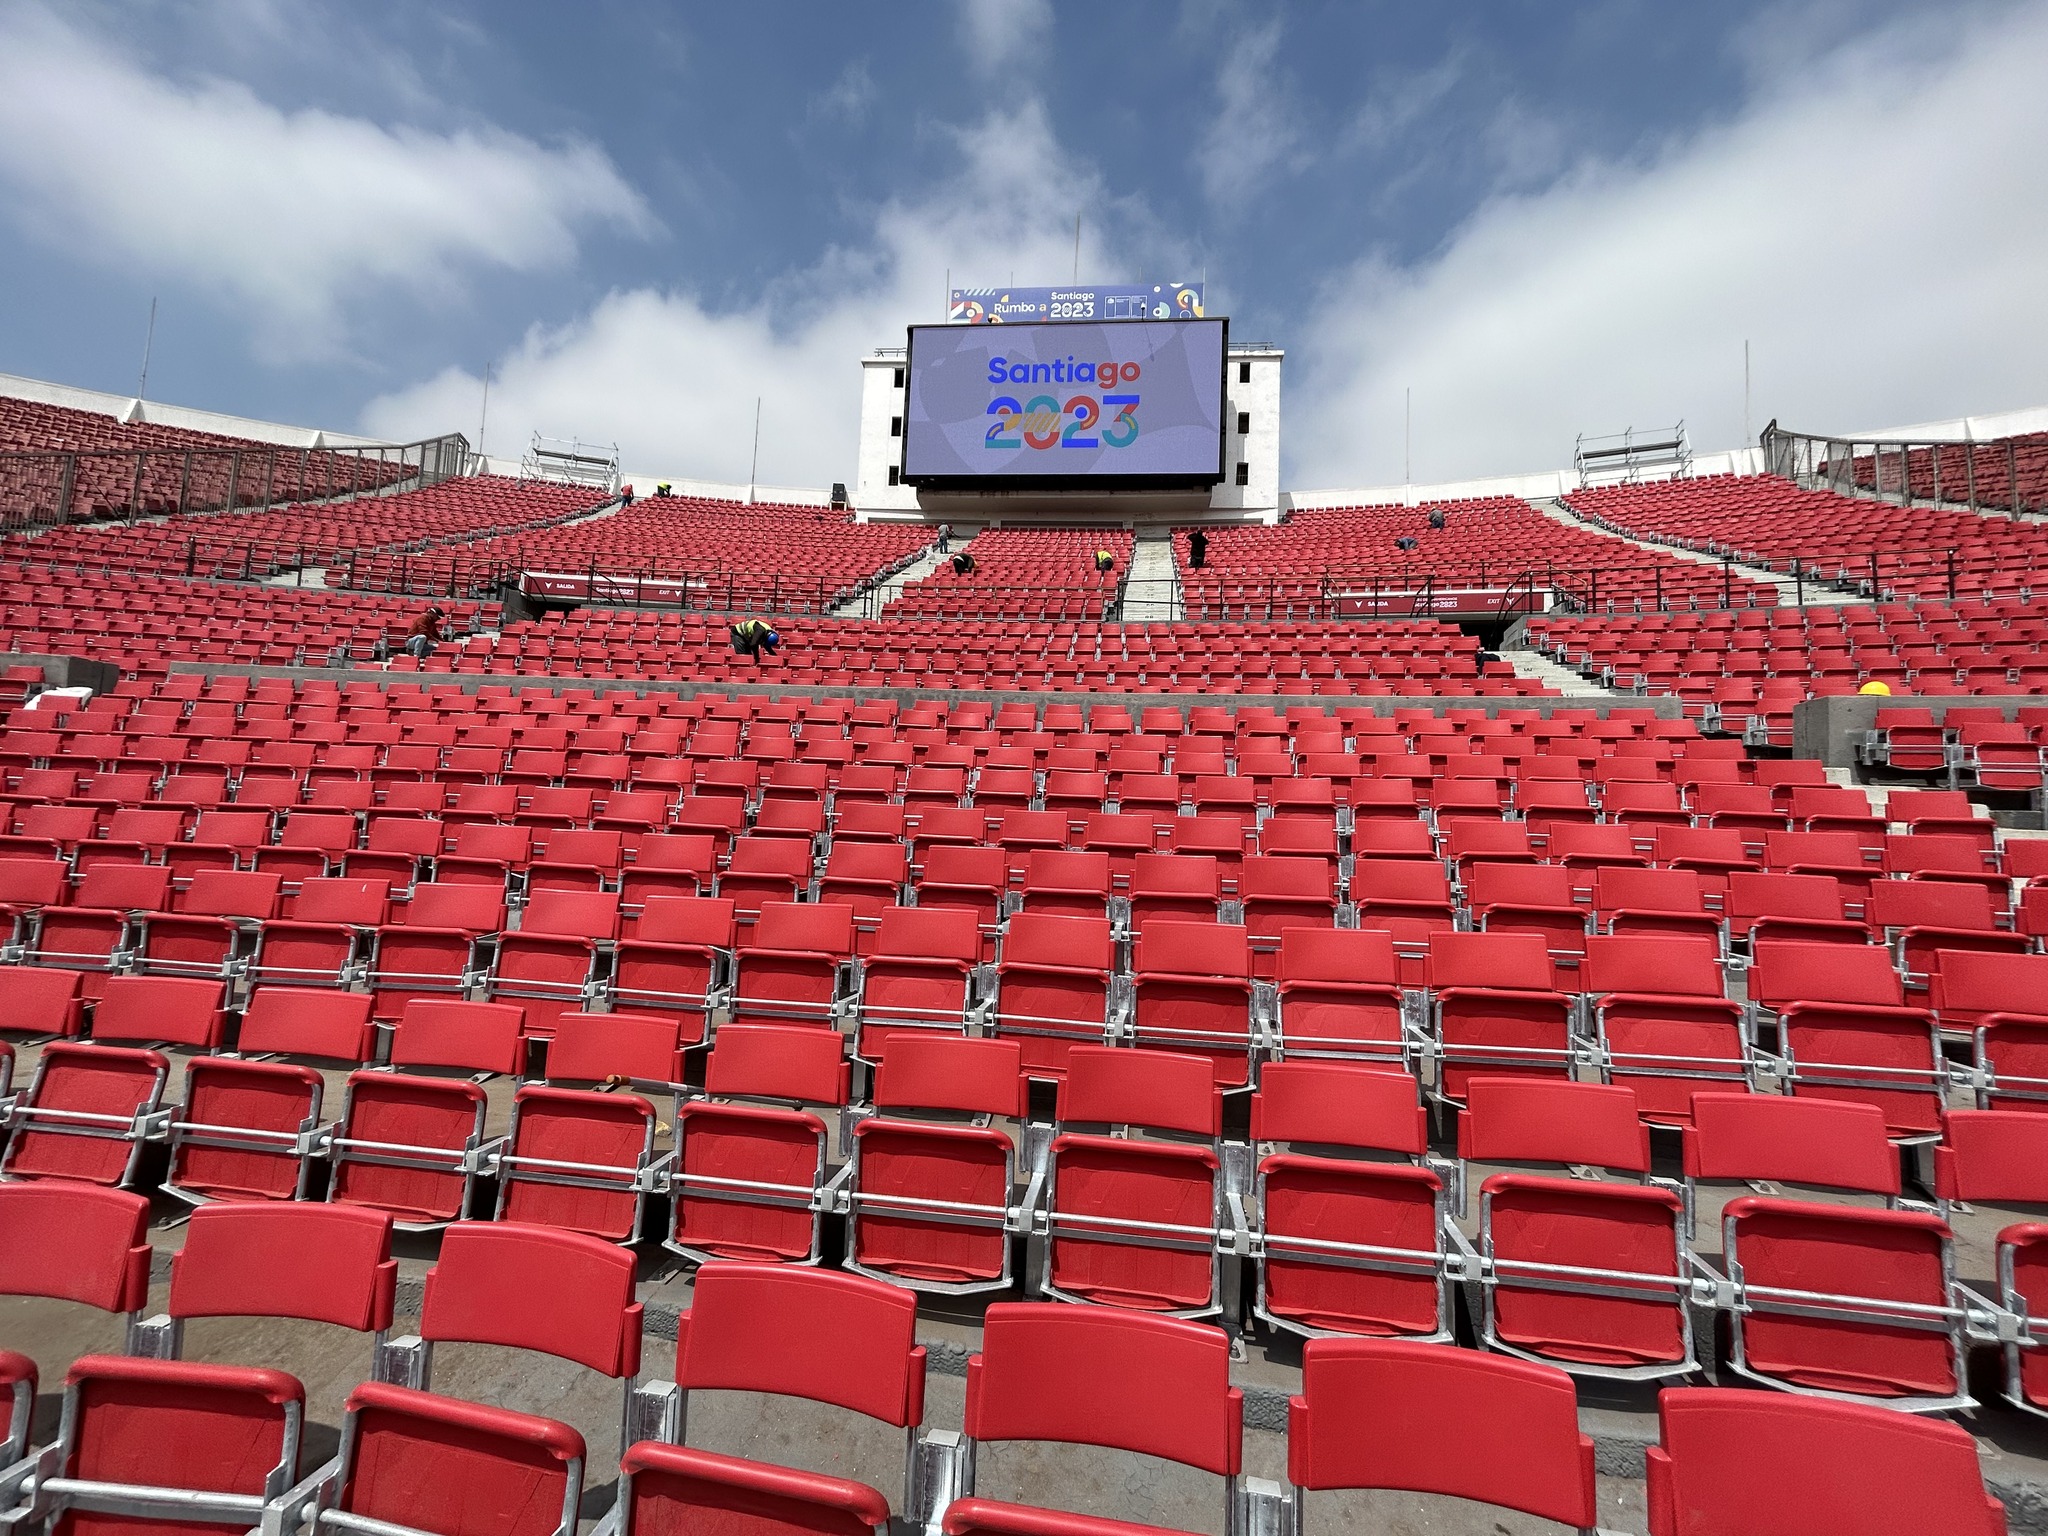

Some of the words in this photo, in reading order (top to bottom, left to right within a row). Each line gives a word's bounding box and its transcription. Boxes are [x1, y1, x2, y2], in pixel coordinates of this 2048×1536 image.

[1051, 291, 1095, 301] Santiago
[994, 302, 1036, 313] Rumbo
[1039, 304, 1047, 312] a
[1050, 302, 1095, 318] 2023
[987, 355, 1141, 389] Santiago
[984, 395, 1141, 450] 2023
